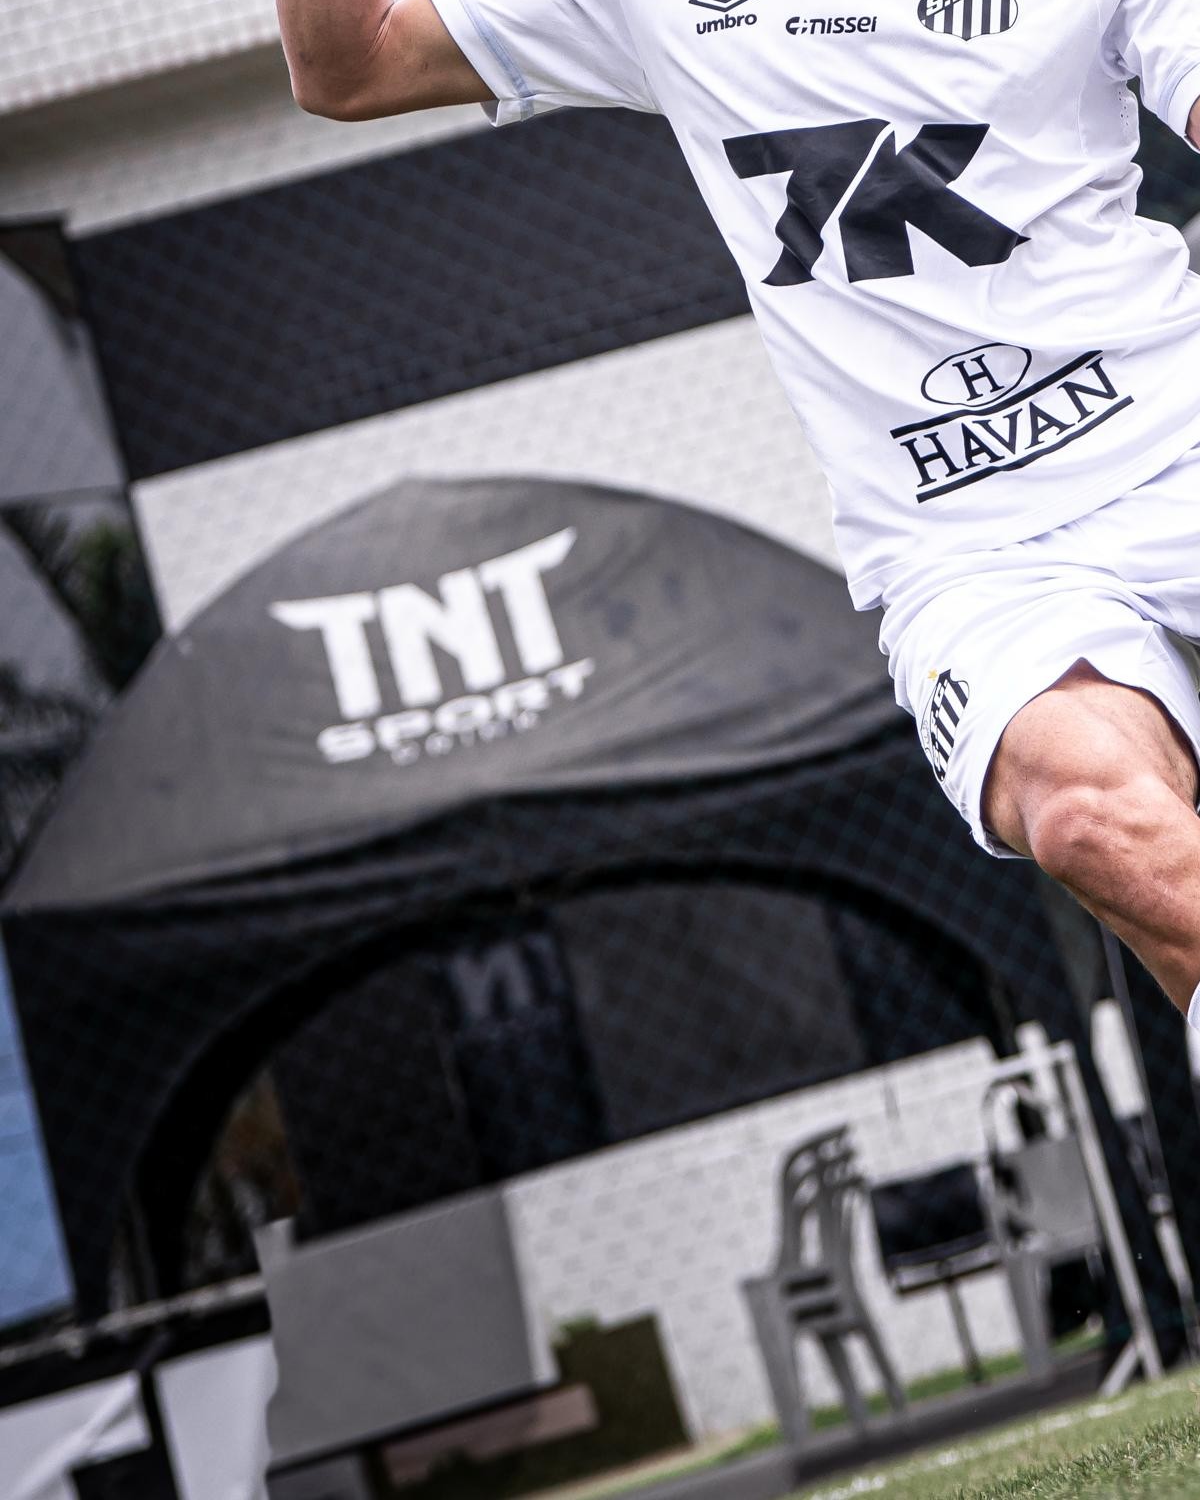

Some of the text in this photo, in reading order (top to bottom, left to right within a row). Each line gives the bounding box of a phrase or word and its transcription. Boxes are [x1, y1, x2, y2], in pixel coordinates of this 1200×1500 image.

[696, 13, 757, 35] umbro
[722, 118, 1031, 286] 7K
[900, 357, 1119, 488] HAVAN
[952, 353, 1004, 401] H
[268, 525, 577, 722] TNT
